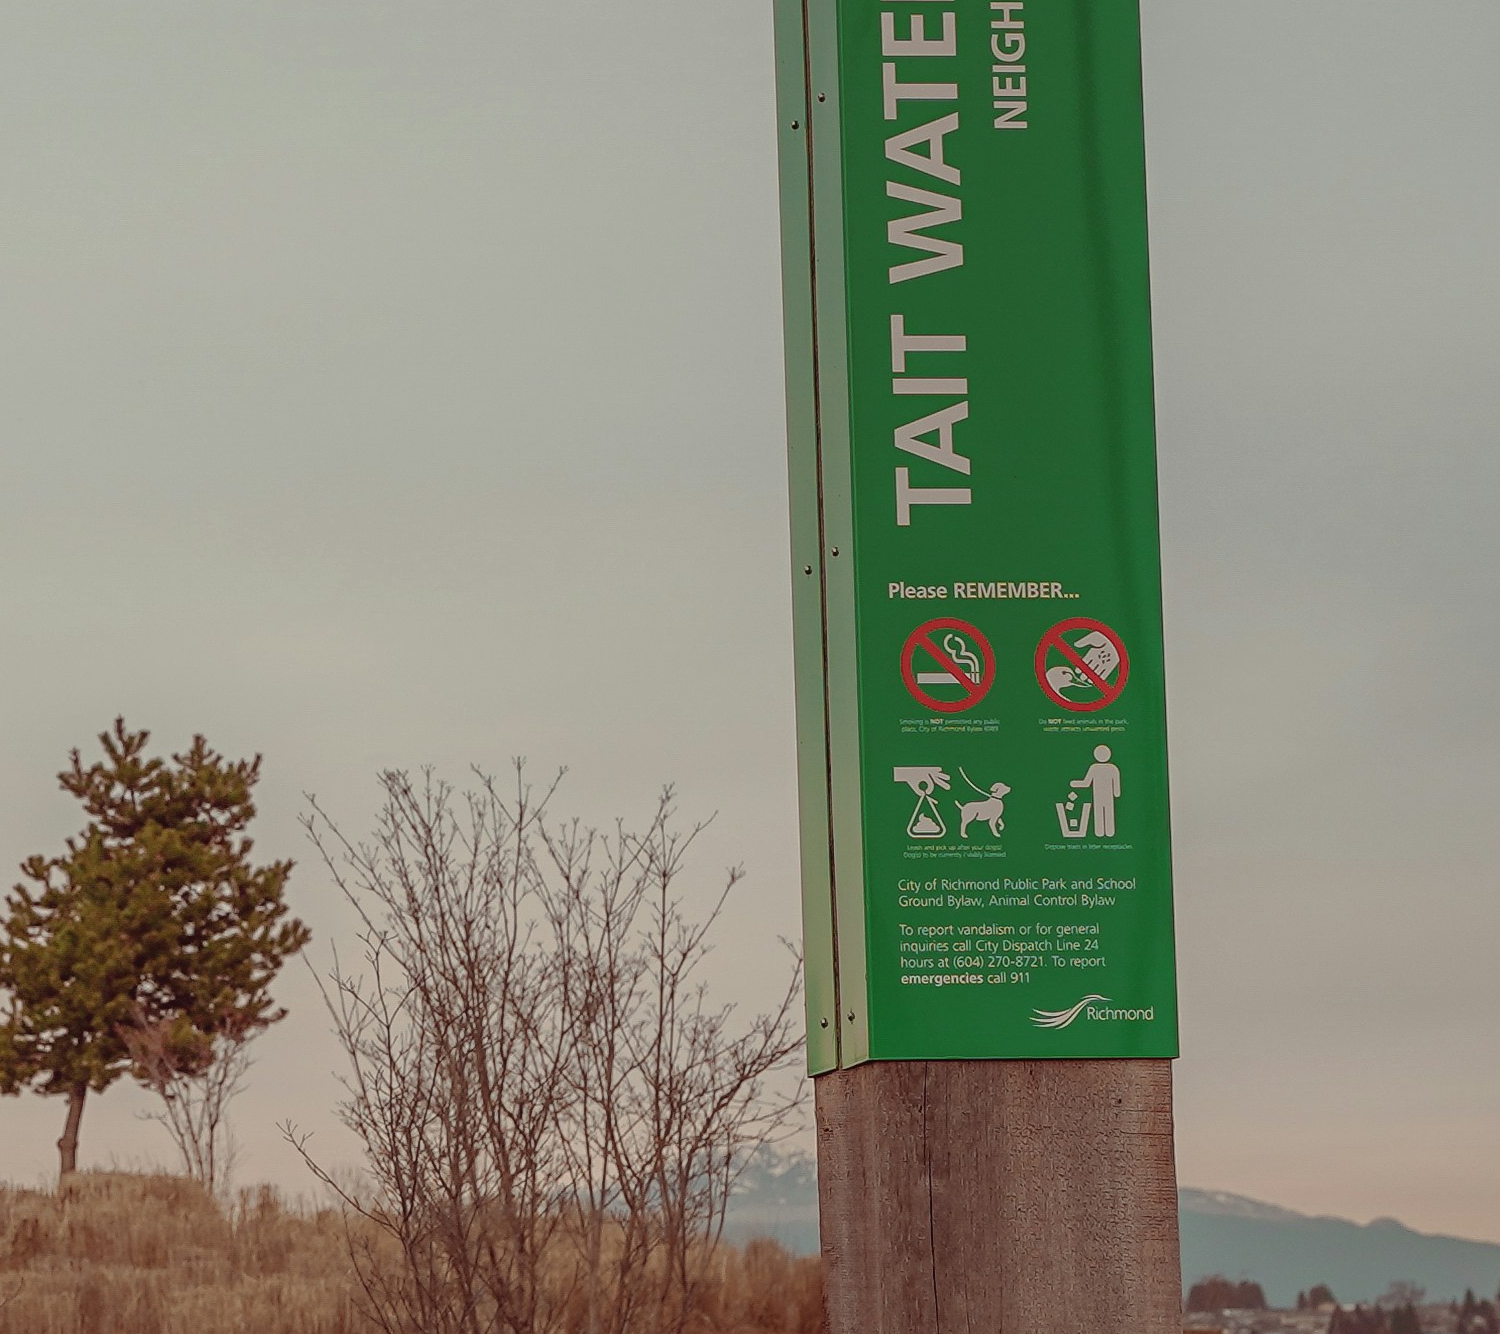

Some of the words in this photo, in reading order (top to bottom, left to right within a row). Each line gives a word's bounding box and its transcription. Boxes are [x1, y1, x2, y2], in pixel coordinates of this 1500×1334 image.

[890, 314, 972, 526] TAIT
[887, 582, 948, 599] Please
[952, 582, 1080, 599] REMEMBER...
[930, 718, 944, 726] NOT
[898, 879, 920, 892] City
[925, 879, 936, 890] of
[941, 879, 1000, 890] Richmond
[1004, 879, 1038, 889] Public
[1042, 879, 1067, 889] Park
[1071, 879, 1093, 889] and
[1097, 878, 1135, 889] School
[899, 896, 943, 907] Ground
[947, 895, 984, 908] Bylaw,
[989, 895, 1029, 906] Animal
[1034, 895, 1077, 906] Control
[1082, 895, 1115, 908] Bylaw
[899, 924, 913, 935] To
[917, 925, 954, 939] report
[957, 924, 1015, 935] vandalism
[1019, 926, 1032, 935] or
[1036, 923, 1052, 935] for
[1056, 923, 1099, 938] general
[900, 940, 949, 954] inquiries
[953, 940, 971, 951] call
[975, 940, 998, 954] City
[1003, 939, 1052, 954] Dispatch
[1056, 940, 1080, 951] Line
[1085, 940, 1098, 950] 24
[901, 957, 934, 968] hours
[938, 957, 949, 968] at
[953, 955, 984, 969] (604)
[1052, 956, 1065, 967] To
[1070, 957, 1105, 969] report
[901, 973, 983, 986] emergencies
[987, 972, 1006, 984] call
[1010, 973, 1030, 984] 911
[1087, 1007, 1153, 1020] Richmond
